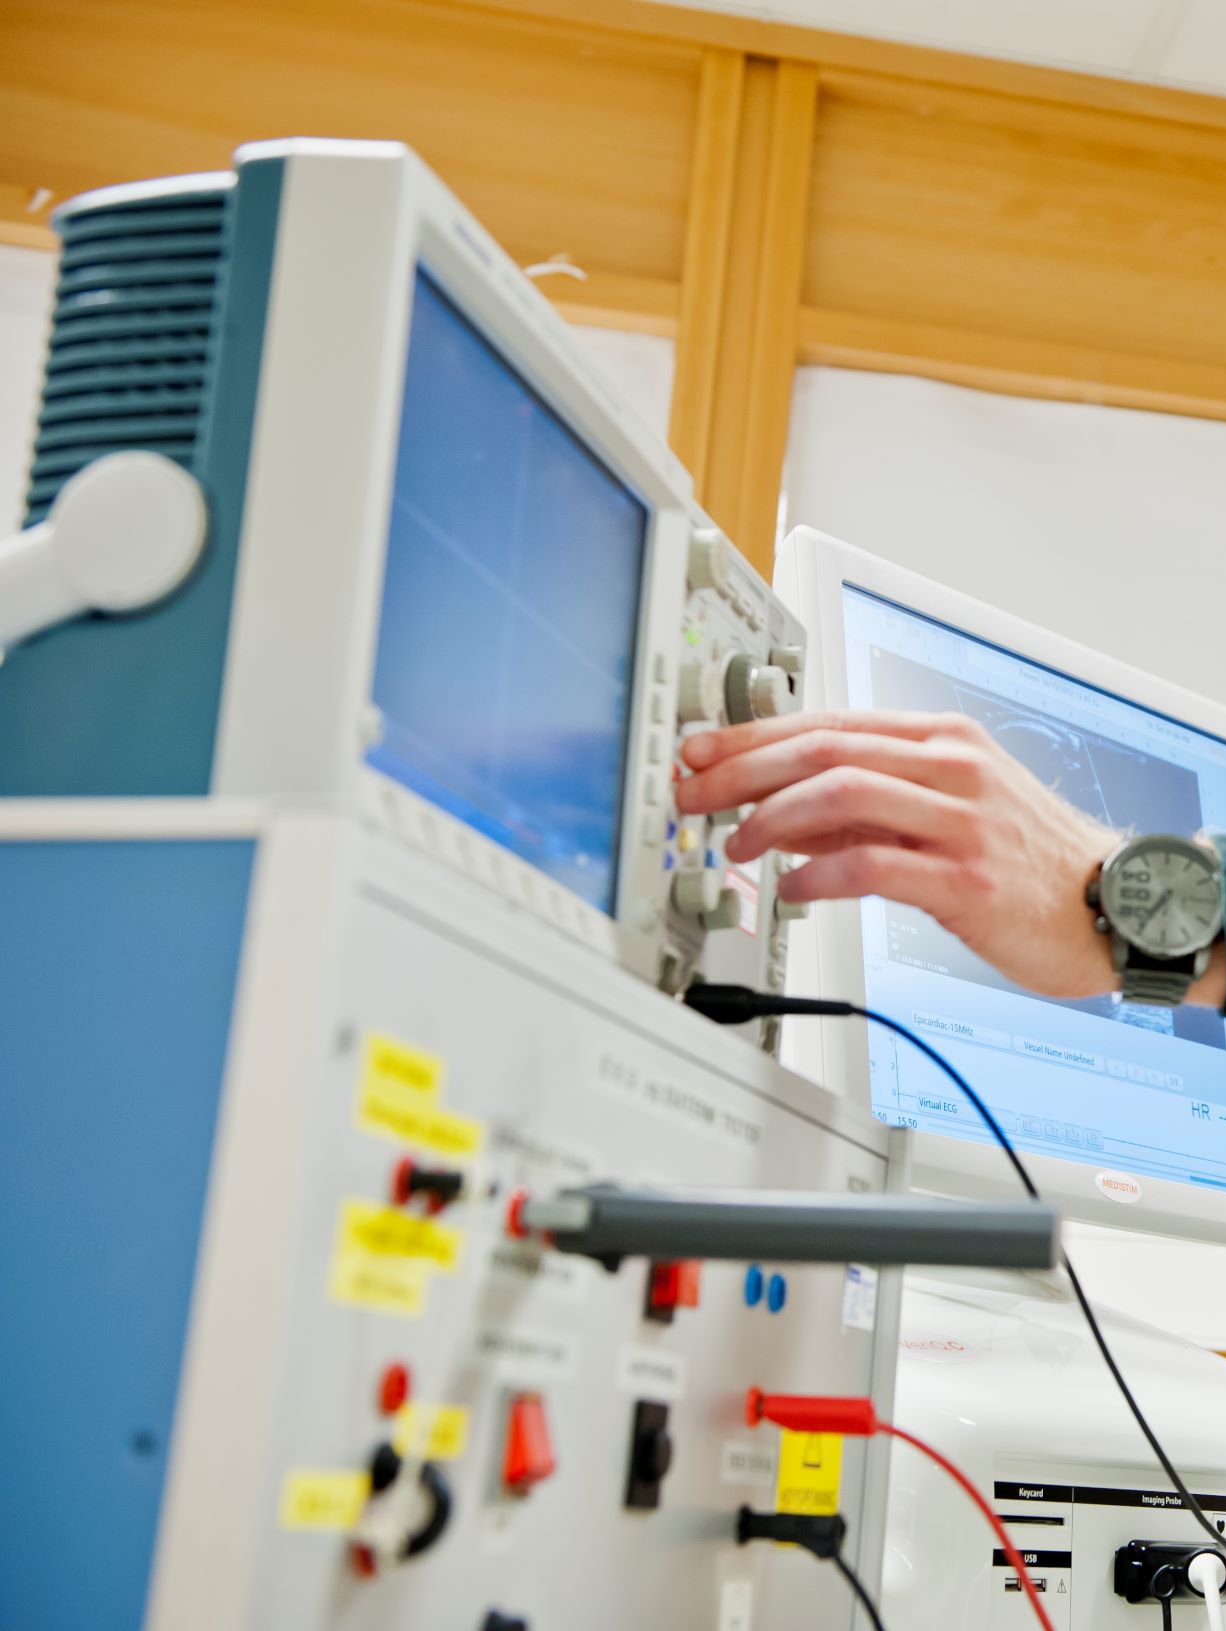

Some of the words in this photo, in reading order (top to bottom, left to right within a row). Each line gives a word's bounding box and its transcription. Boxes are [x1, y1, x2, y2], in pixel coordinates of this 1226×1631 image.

[913, 1013, 974, 1037] Epicardiac-15MHz
[1023, 1041, 1044, 1054] Vessel
[1044, 1046, 1063, 1058] Name
[1064, 1050, 1095, 1066] Undefined
[918, 1097, 942, 1111] Virtual
[943, 1102, 958, 1114] ECG
[1191, 1101, 1212, 1121] HR
[1019, 1487, 1044, 1499] Keycard
[1142, 1494, 1165, 1506] Imaging
[1165, 1496, 1182, 1506] Probe
[1024, 1553, 1038, 1563] USB
